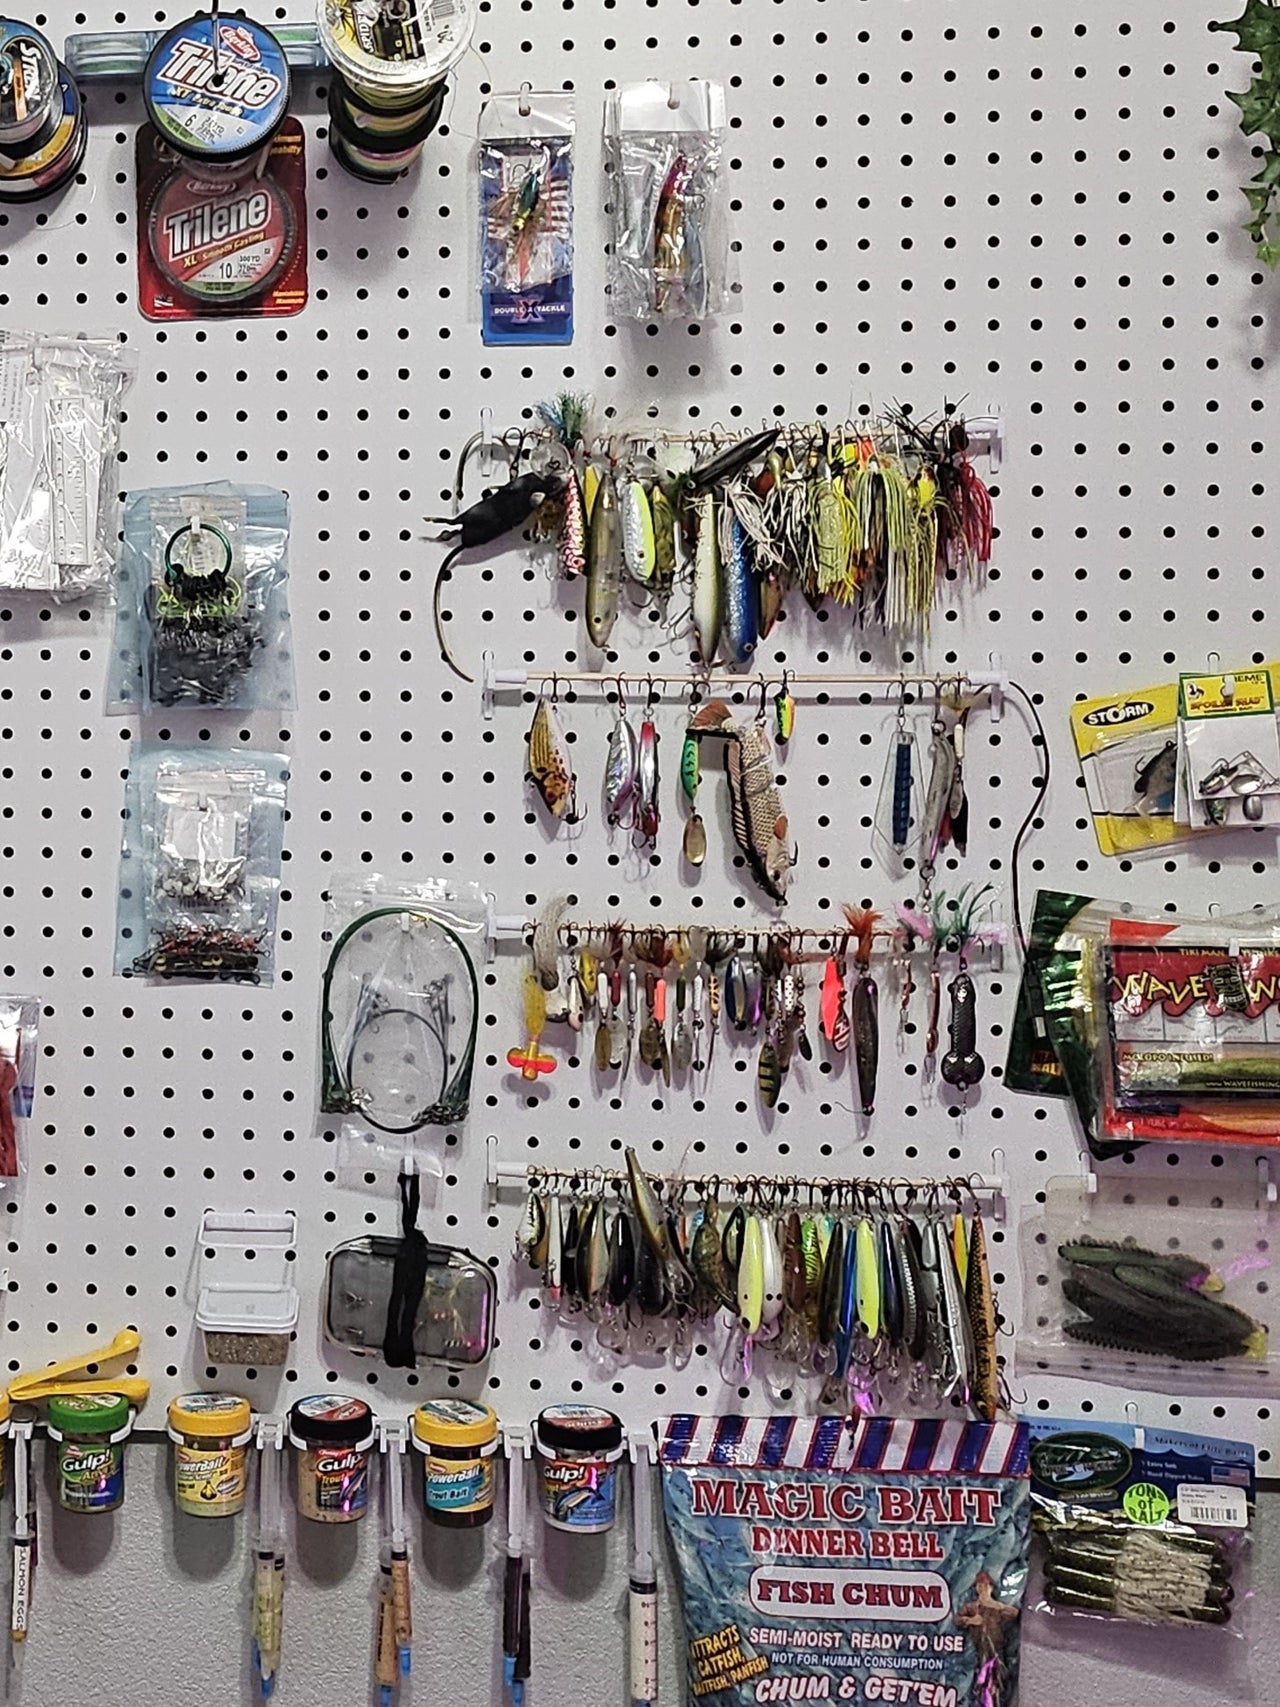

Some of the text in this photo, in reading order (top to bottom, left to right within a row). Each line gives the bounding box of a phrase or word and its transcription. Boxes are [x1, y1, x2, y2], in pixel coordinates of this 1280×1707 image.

[185, 114, 197, 127] 6
[168, 193, 269, 255] Trilene
[183, 254, 197, 268] XL
[220, 263, 233, 279] 10
[537, 304, 566, 313] TACKLE
[1087, 703, 1150, 726] STORM
[1113, 971, 1207, 1005] WAVE
[63, 1449, 110, 1471] Gulp!
[544, 1465, 586, 1480] Gulp!
[450, 1487, 468, 1498] Bait
[692, 1479, 1001, 1526] MAGIC BAIT
[1128, 1484, 1166, 1501] TONS
[1138, 1498, 1154, 1509] of
[1128, 1507, 1165, 1524] BAIT
[751, 1525, 944, 1560] DINNER BELL
[18, 1547, 27, 1596] SALMON
[757, 1579, 944, 1608] FISH CHUM
[749, 1627, 964, 1652] SEMI-MOIST READY TO USE
[698, 1646, 746, 1677] CATFISH,
[730, 1655, 769, 1683] PANFISH
[771, 1652, 944, 1671] NOT FOR HUMAN CONSUMPTION
[754, 1675, 959, 1707] CHUM & GET'EM
